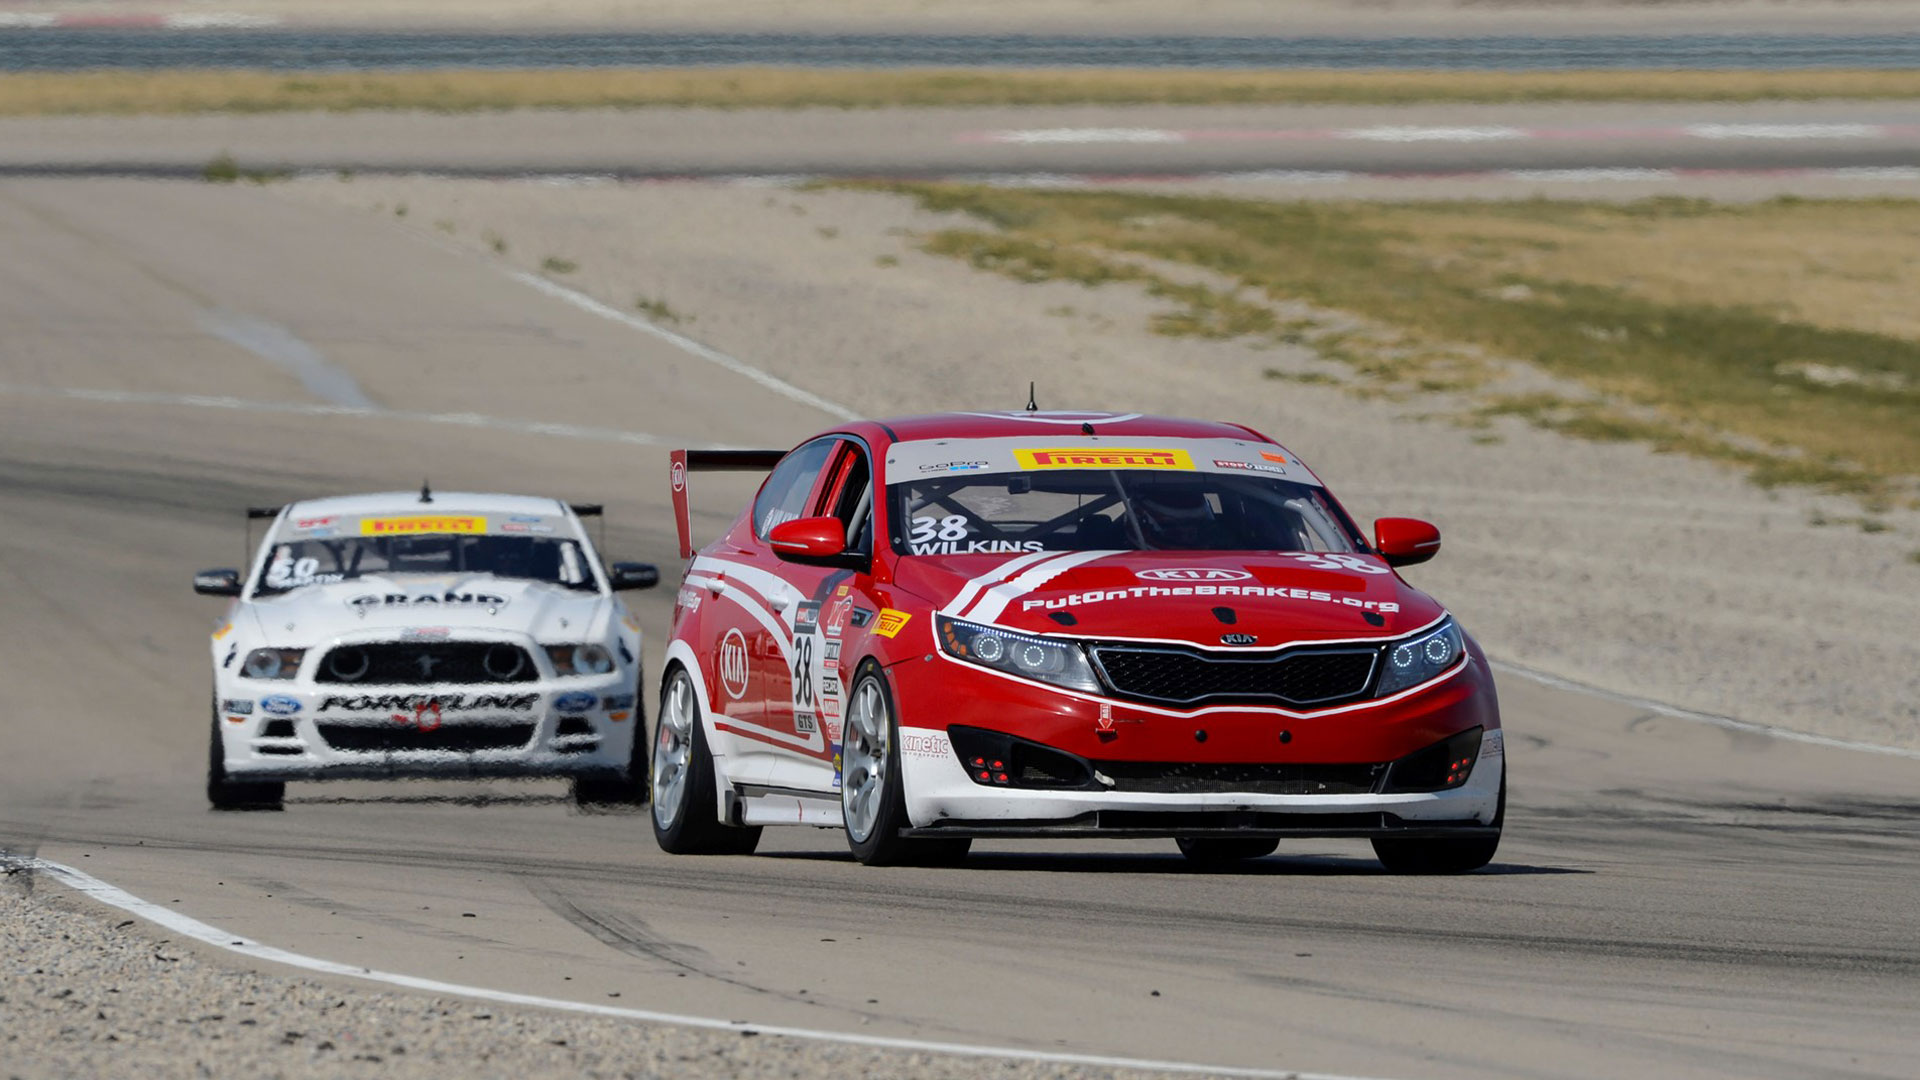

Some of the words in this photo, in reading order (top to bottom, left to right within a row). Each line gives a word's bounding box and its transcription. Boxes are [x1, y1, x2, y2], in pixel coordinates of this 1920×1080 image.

[1032, 452, 1176, 466] PIRELLI
[910, 515, 968, 543] 38
[911, 540, 1044, 556] WILKINS
[1276, 552, 1390, 575] 38
[1154, 570, 1228, 581] KIA
[1224, 633, 1254, 645] KIA
[795, 636, 812, 708] 38
[798, 714, 813, 730] GTS
[903, 734, 949, 754] kinetic
